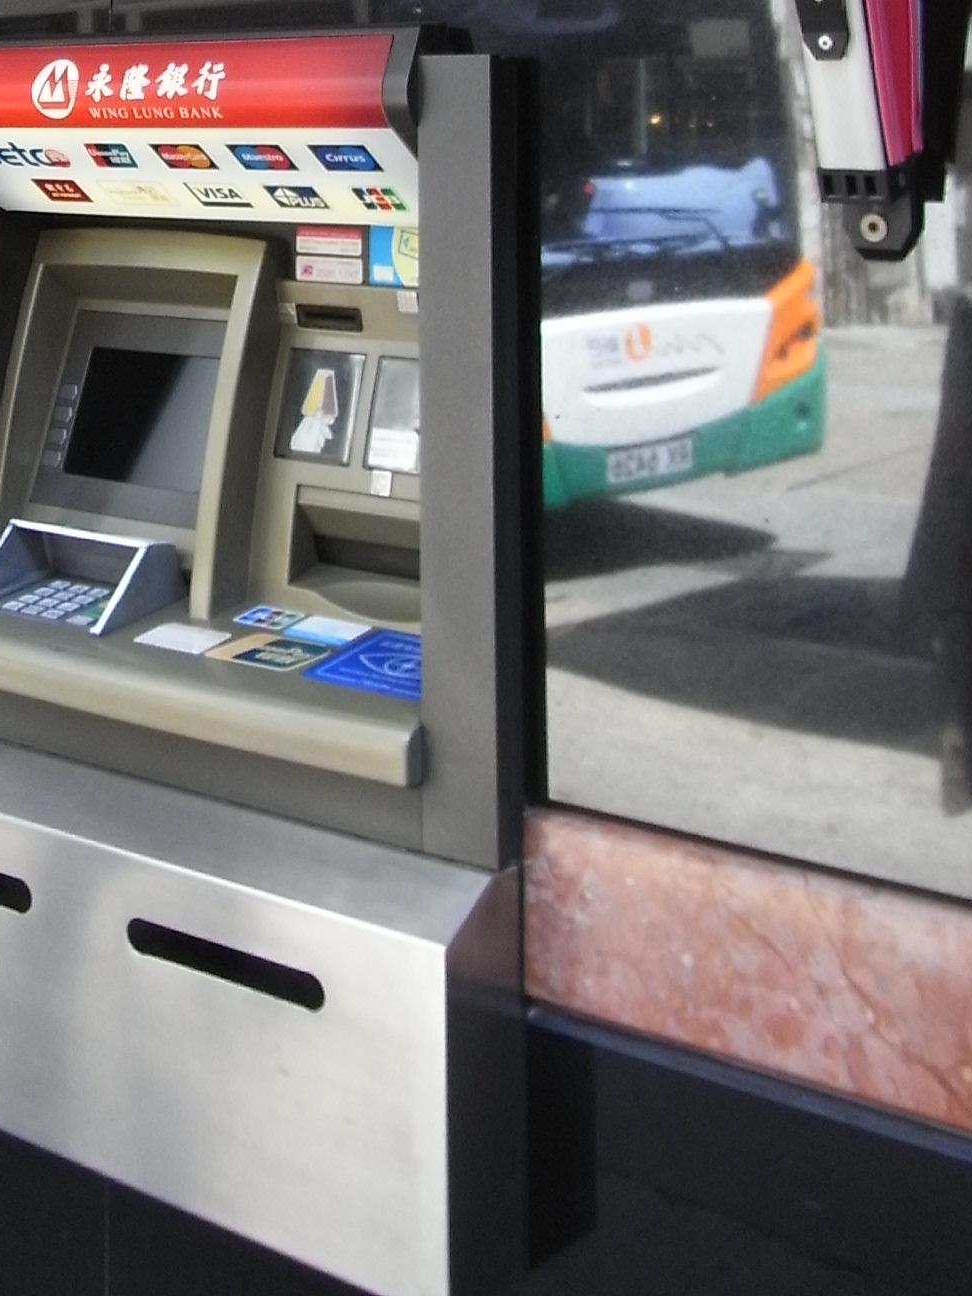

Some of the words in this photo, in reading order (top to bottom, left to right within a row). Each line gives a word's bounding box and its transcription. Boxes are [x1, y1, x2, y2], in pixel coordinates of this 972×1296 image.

[84, 60, 226, 102] 永隆銀行
[89, 106, 129, 120] WING
[133, 106, 175, 120] LUNG
[180, 105, 223, 119] BANK
[242, 151, 284, 163] Maestro
[198, 186, 242, 202] VISA
[288, 196, 327, 209] PLUS
